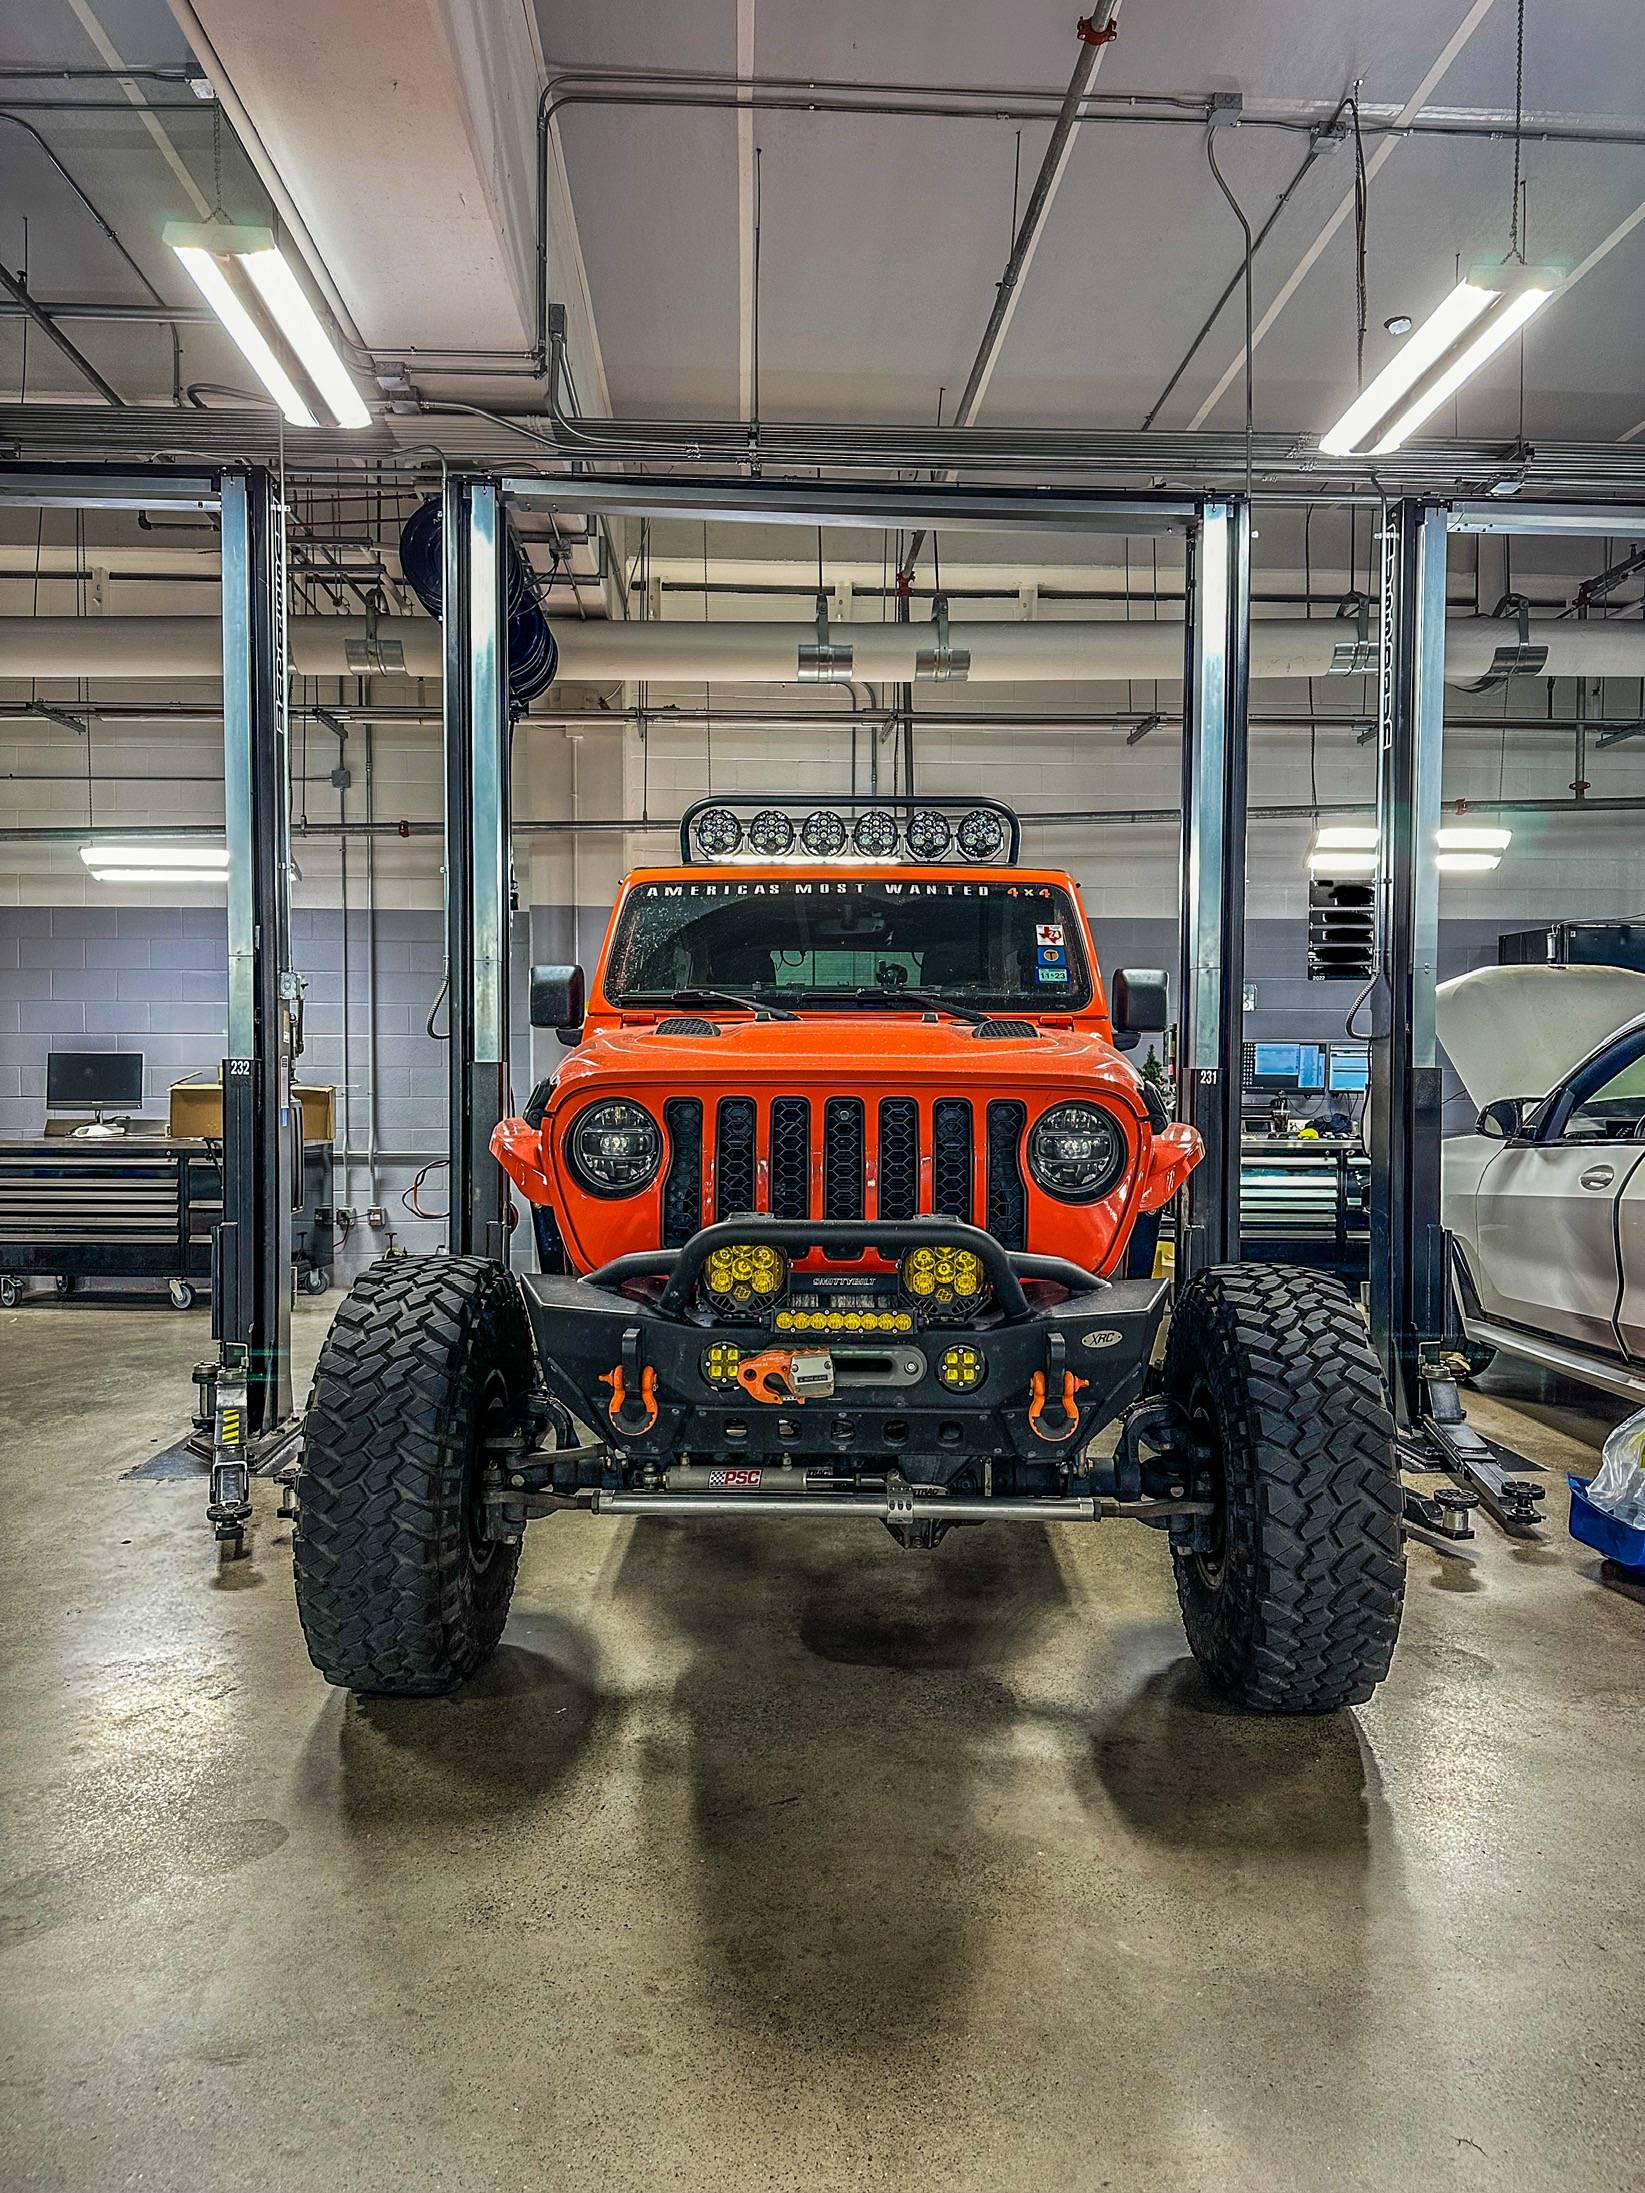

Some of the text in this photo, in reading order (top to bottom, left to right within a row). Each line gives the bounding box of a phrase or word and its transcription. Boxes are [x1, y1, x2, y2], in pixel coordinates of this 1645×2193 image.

[646, 883, 780, 897] AMERICAS
[794, 883, 866, 895] MOST
[884, 883, 990, 897] WANTED
[1048, 930, 1060, 939] 24
[230, 1060, 250, 1076] 232
[1199, 1069, 1217, 1085] 231
[1089, 1332, 1115, 1346] XRC
[724, 1470, 760, 1485] PSC
